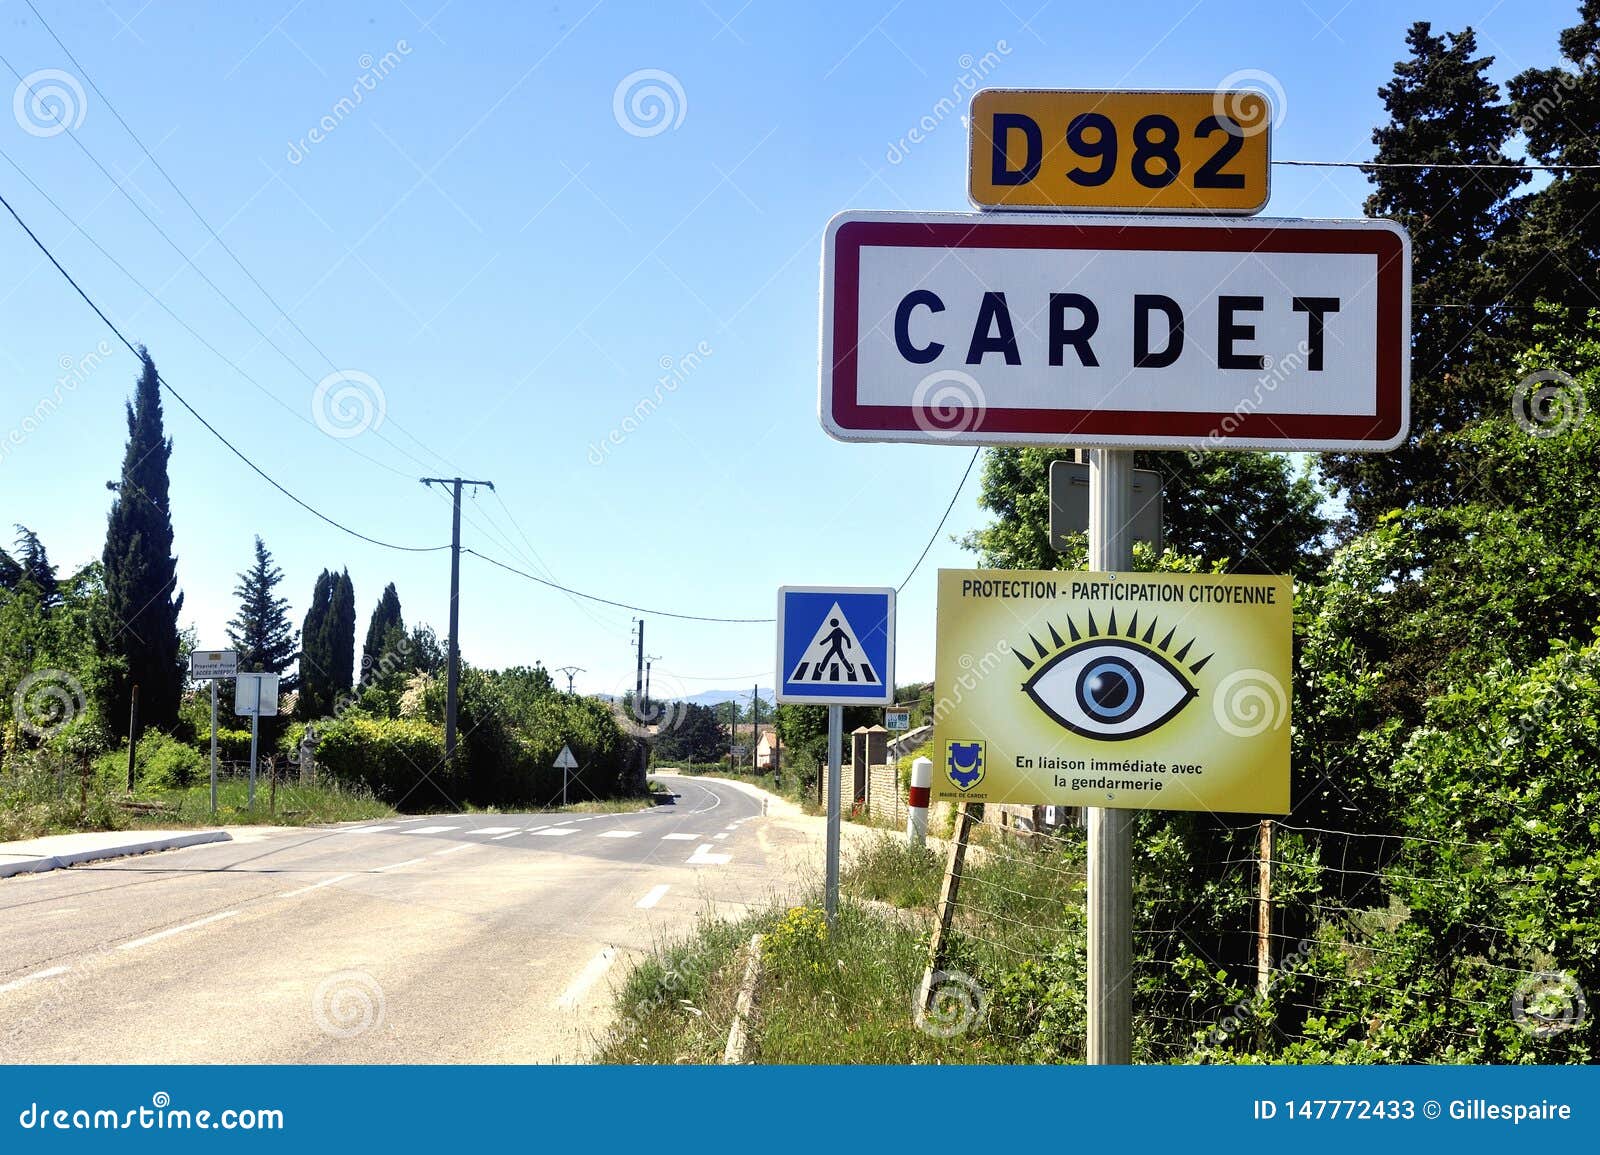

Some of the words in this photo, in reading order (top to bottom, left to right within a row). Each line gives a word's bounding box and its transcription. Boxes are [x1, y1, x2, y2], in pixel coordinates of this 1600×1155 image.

[893, 289, 1341, 372] CARDET
[962, 579, 1057, 599] PROTECTION
[1072, 582, 1185, 602] PARTICIPATION
[1189, 584, 1276, 605] CITOYENNE
[1016, 755, 1033, 769] En
[1038, 756, 1085, 770] liaison
[1090, 758, 1167, 773] immédiate
[1171, 763, 1203, 775] avec
[1054, 774, 1067, 787] la
[1071, 776, 1163, 791] gendarmerie
